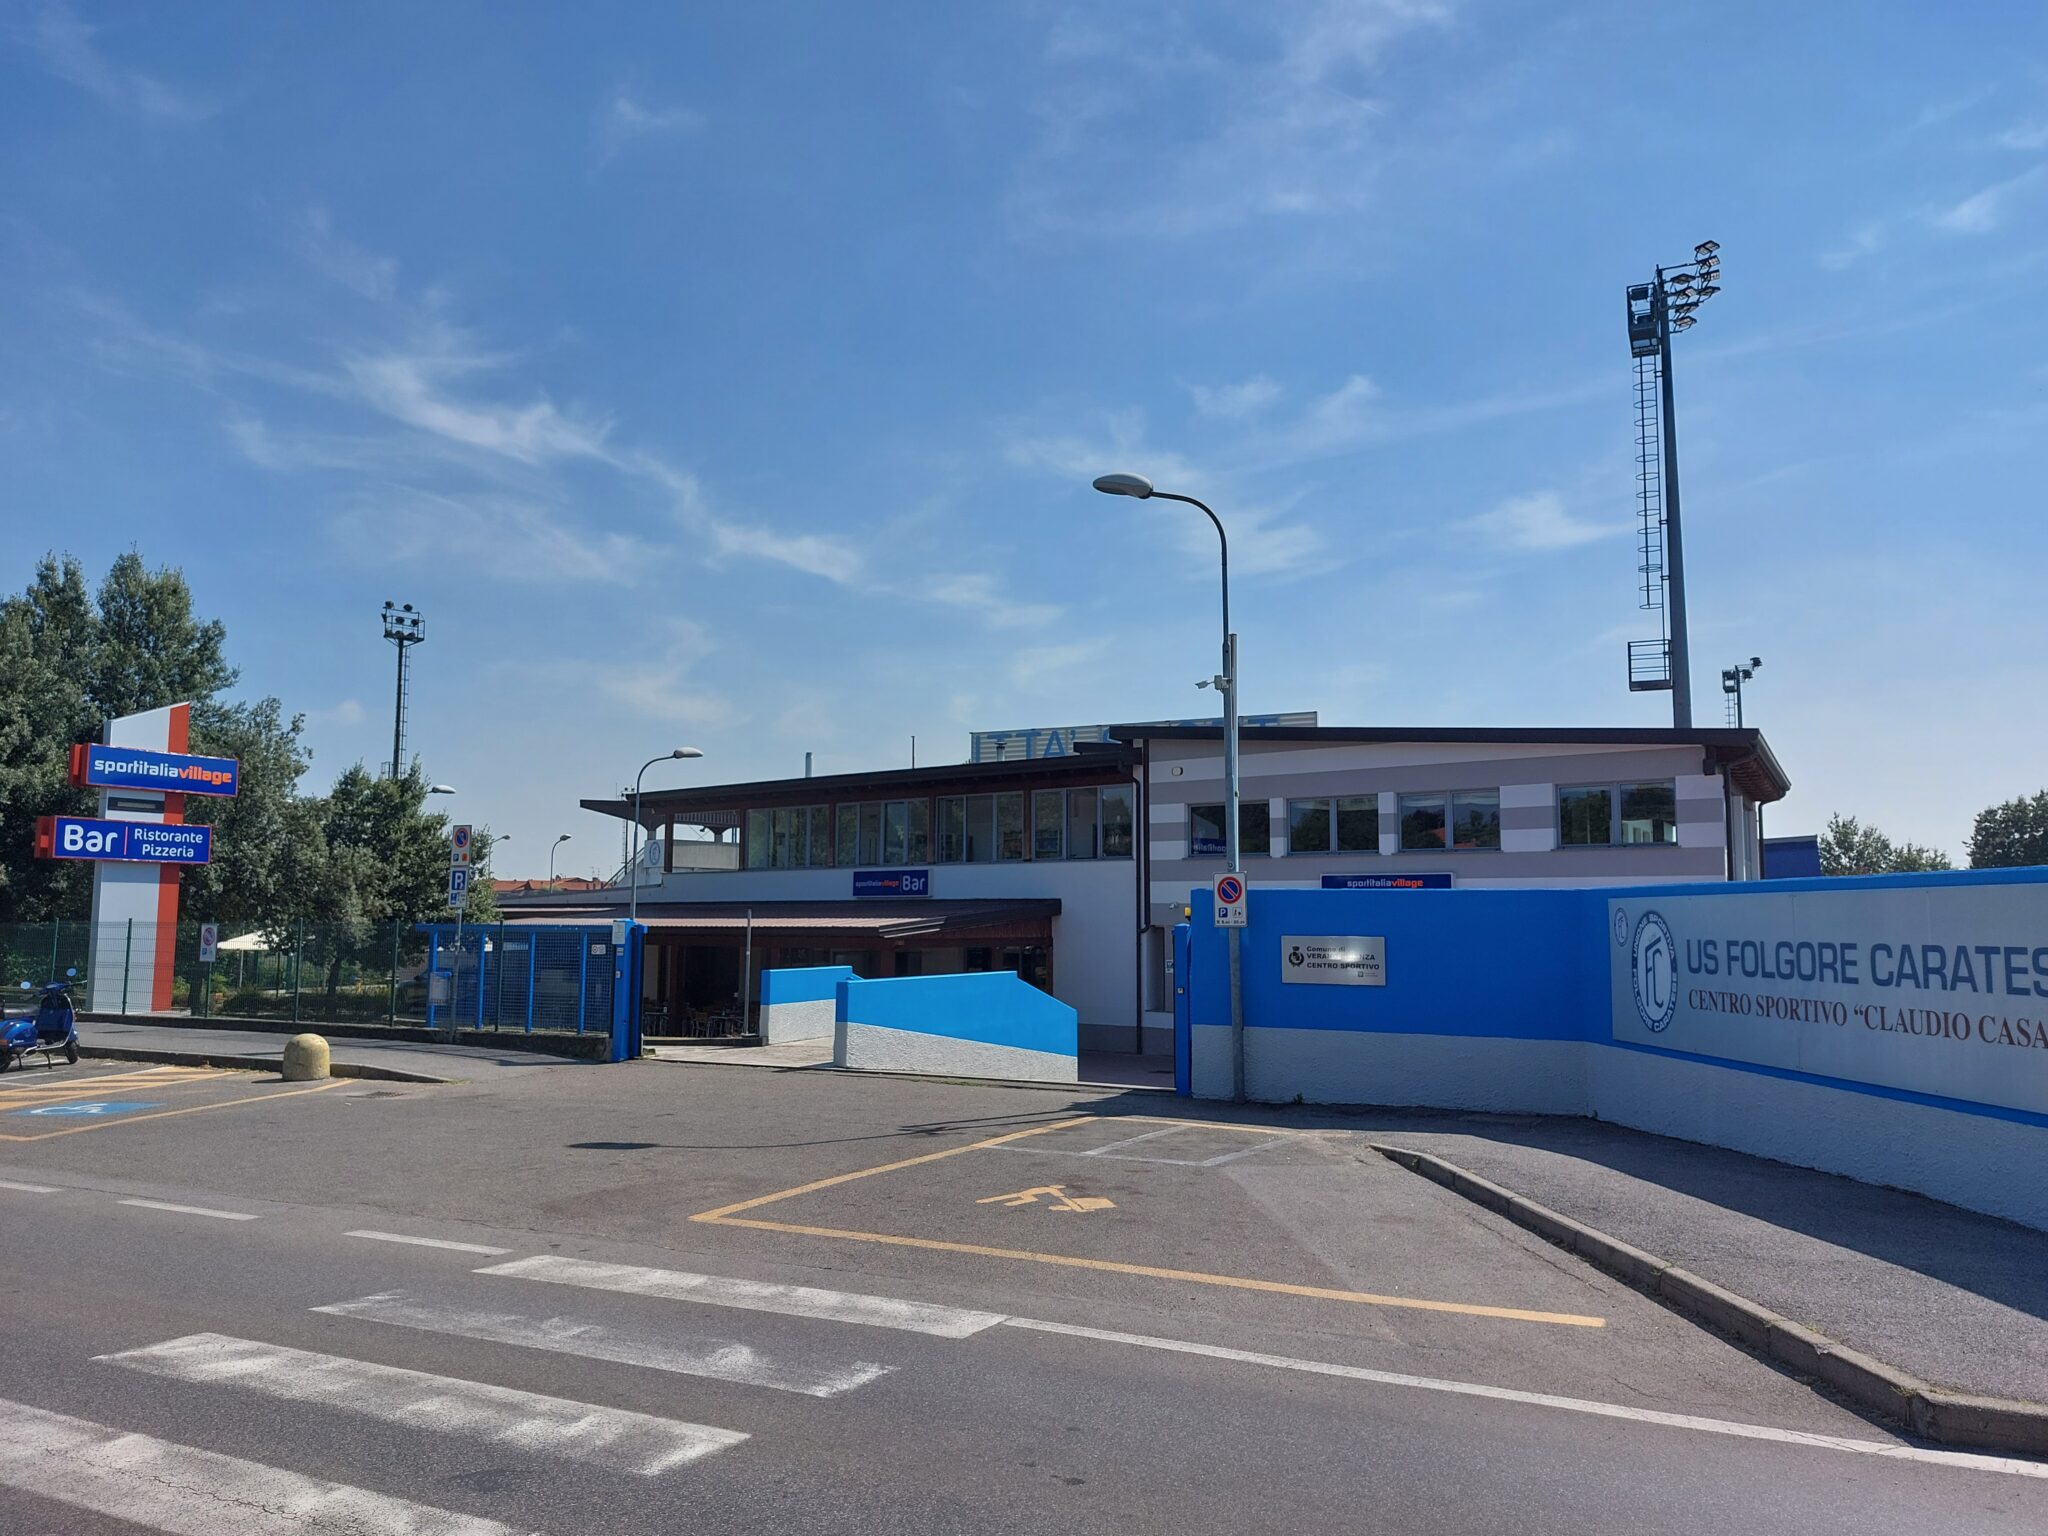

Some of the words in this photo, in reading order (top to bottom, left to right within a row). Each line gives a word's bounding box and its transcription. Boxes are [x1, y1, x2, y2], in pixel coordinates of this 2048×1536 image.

[94, 759, 232, 785] sportitaliavillage
[63, 824, 118, 852] Bar
[134, 828, 204, 843] Ristorante
[142, 844, 194, 858] Pizzeria
[903, 875, 926, 891] Bar
[1340, 962, 1380, 970] SPORTIVO
[1686, 939, 1719, 975] US
[1726, 940, 1859, 984] FOLGORE
[1870, 943, 2048, 998] CARATES
[1688, 988, 1752, 1016] CENTRO
[1756, 994, 1847, 1027] SPORTIVO
[1978, 1014, 2048, 1050] CASA
